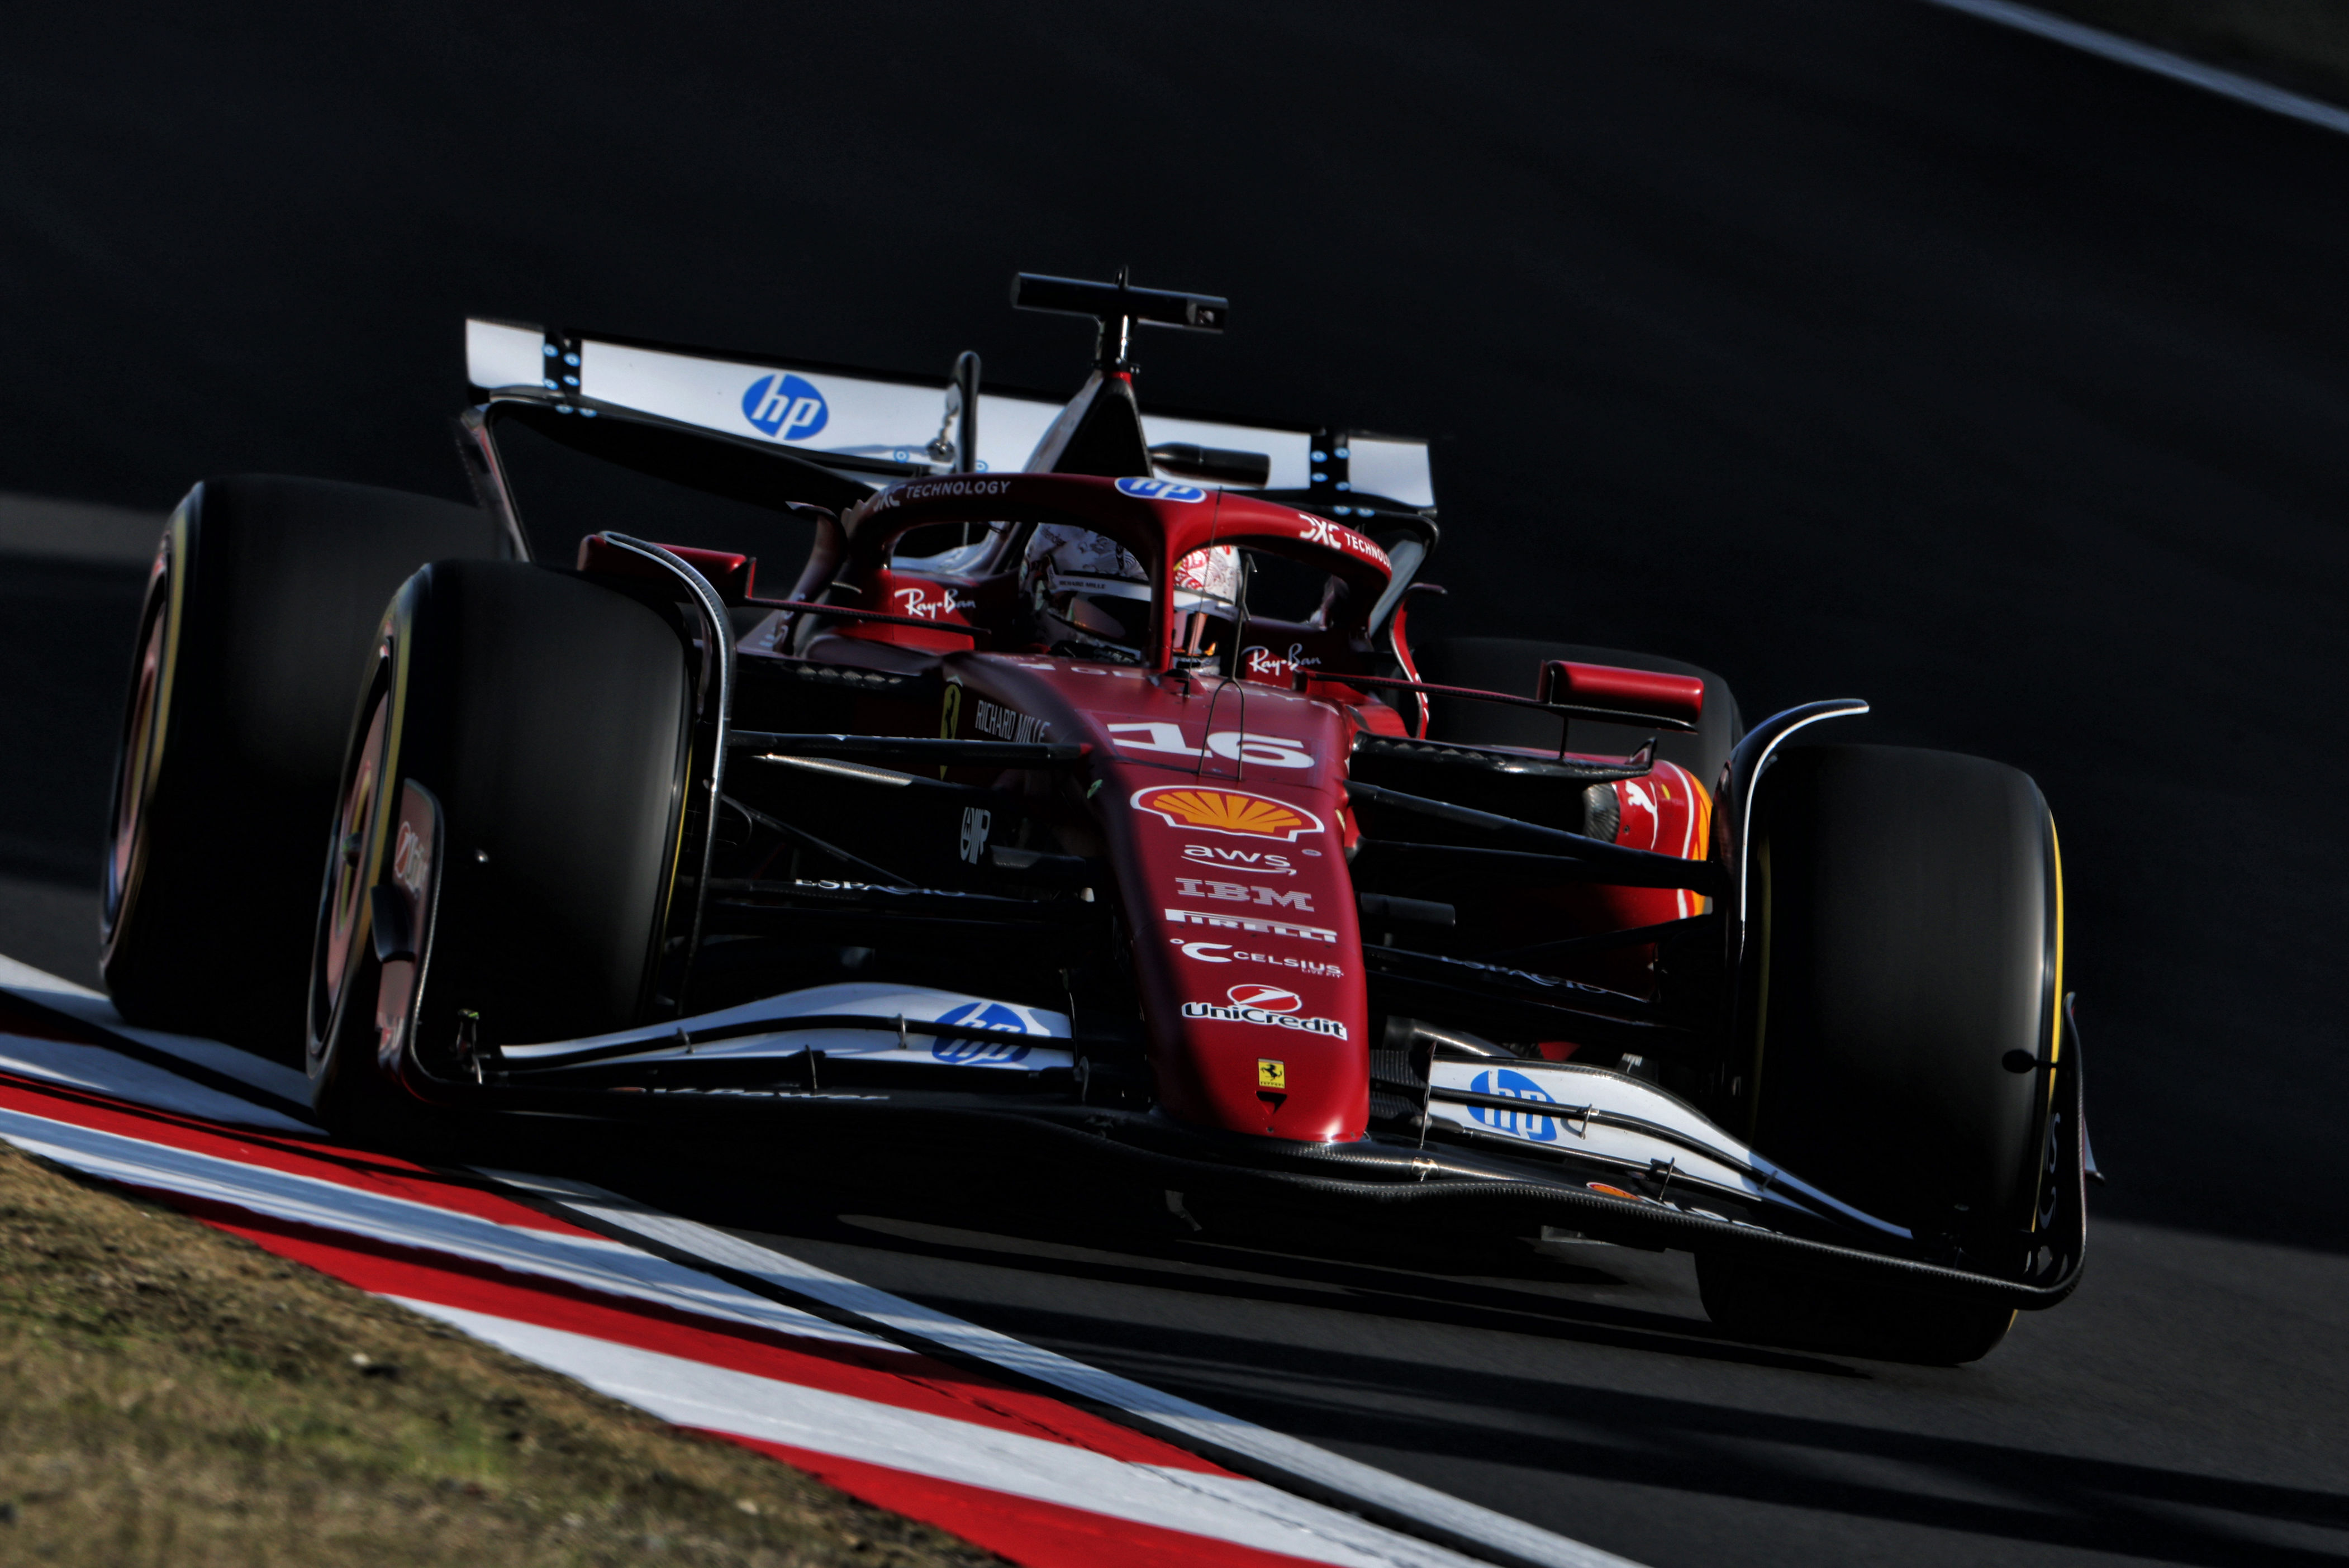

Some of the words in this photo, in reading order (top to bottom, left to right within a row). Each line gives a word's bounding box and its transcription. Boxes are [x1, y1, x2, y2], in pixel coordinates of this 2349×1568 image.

[750, 374, 823, 440] hp
[906, 479, 1012, 498] TECHNOLOGY
[1128, 477, 1193, 500] hp
[1298, 512, 1343, 550] DXC
[894, 587, 977, 619] Ray-Ban
[1240, 642, 1322, 677] Ray-Ban
[974, 699, 1016, 739] RICHARD
[1106, 721, 1315, 769] 16
[1183, 844, 1291, 868] aws
[1174, 877, 1315, 912] IBM
[1164, 908, 1338, 943] PIRELLI
[1233, 951, 1342, 975] CELSIUS
[1184, 1002, 1347, 1039] UniCredit
